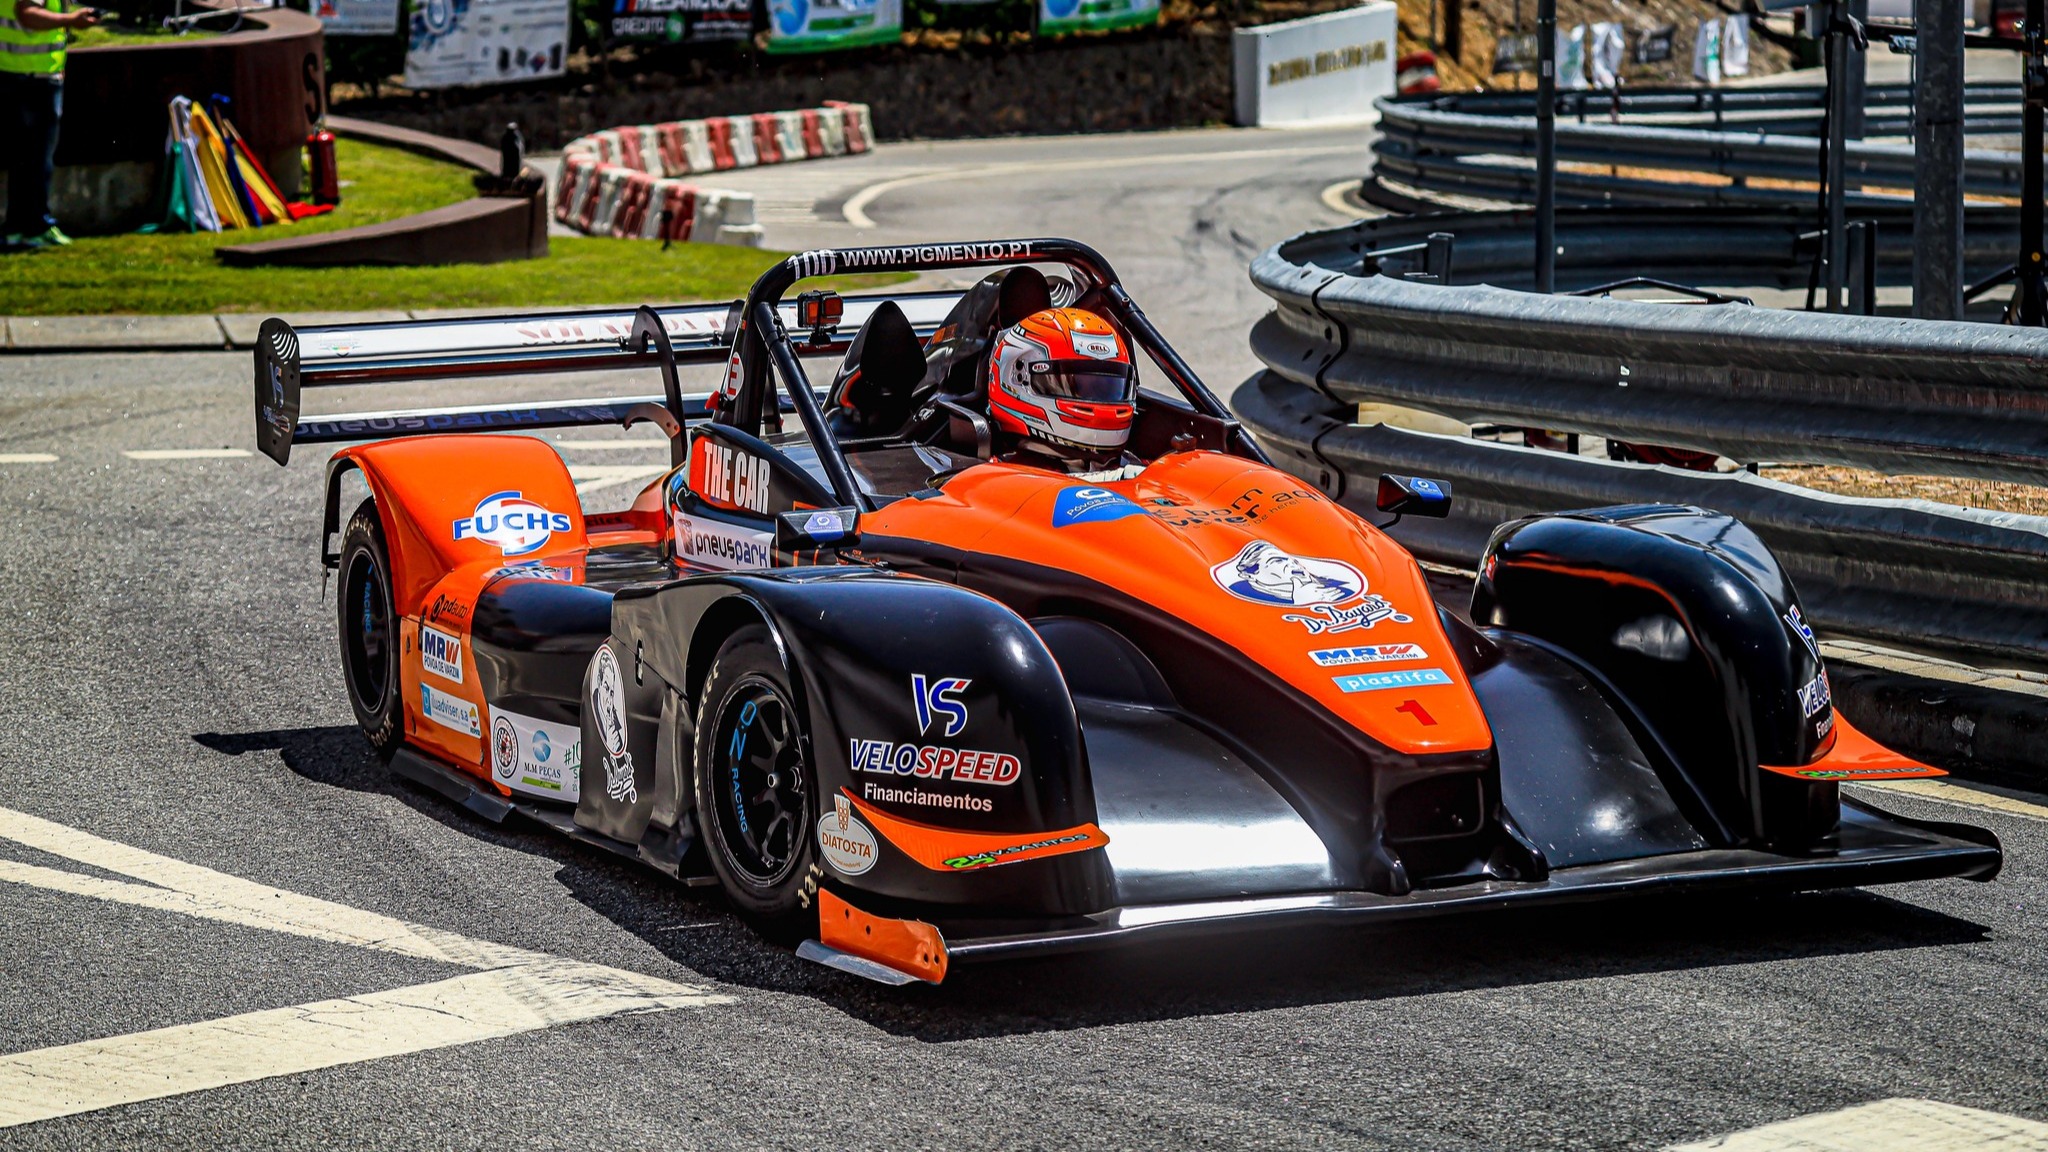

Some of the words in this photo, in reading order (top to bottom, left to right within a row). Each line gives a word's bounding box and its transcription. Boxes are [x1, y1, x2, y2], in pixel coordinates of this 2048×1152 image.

[842, 242, 1033, 267] WWW.PIGMENTO.PT
[728, 357, 740, 396] E
[704, 441, 732, 502] THE
[734, 450, 771, 515] CAR
[454, 513, 571, 540] FUCHS
[695, 532, 767, 568] pneuspark
[364, 580, 372, 633] RACING
[424, 631, 460, 665] MRW
[1315, 644, 1414, 661] MRW
[1346, 671, 1439, 691] plastifa
[1395, 699, 1438, 726] 1
[539, 765, 562, 780] PEÇAS
[850, 737, 1021, 786] VELOSPEED
[731, 767, 748, 833] RACING
[865, 781, 993, 812] Financiamentos
[822, 831, 872, 859] DIATOSTA
